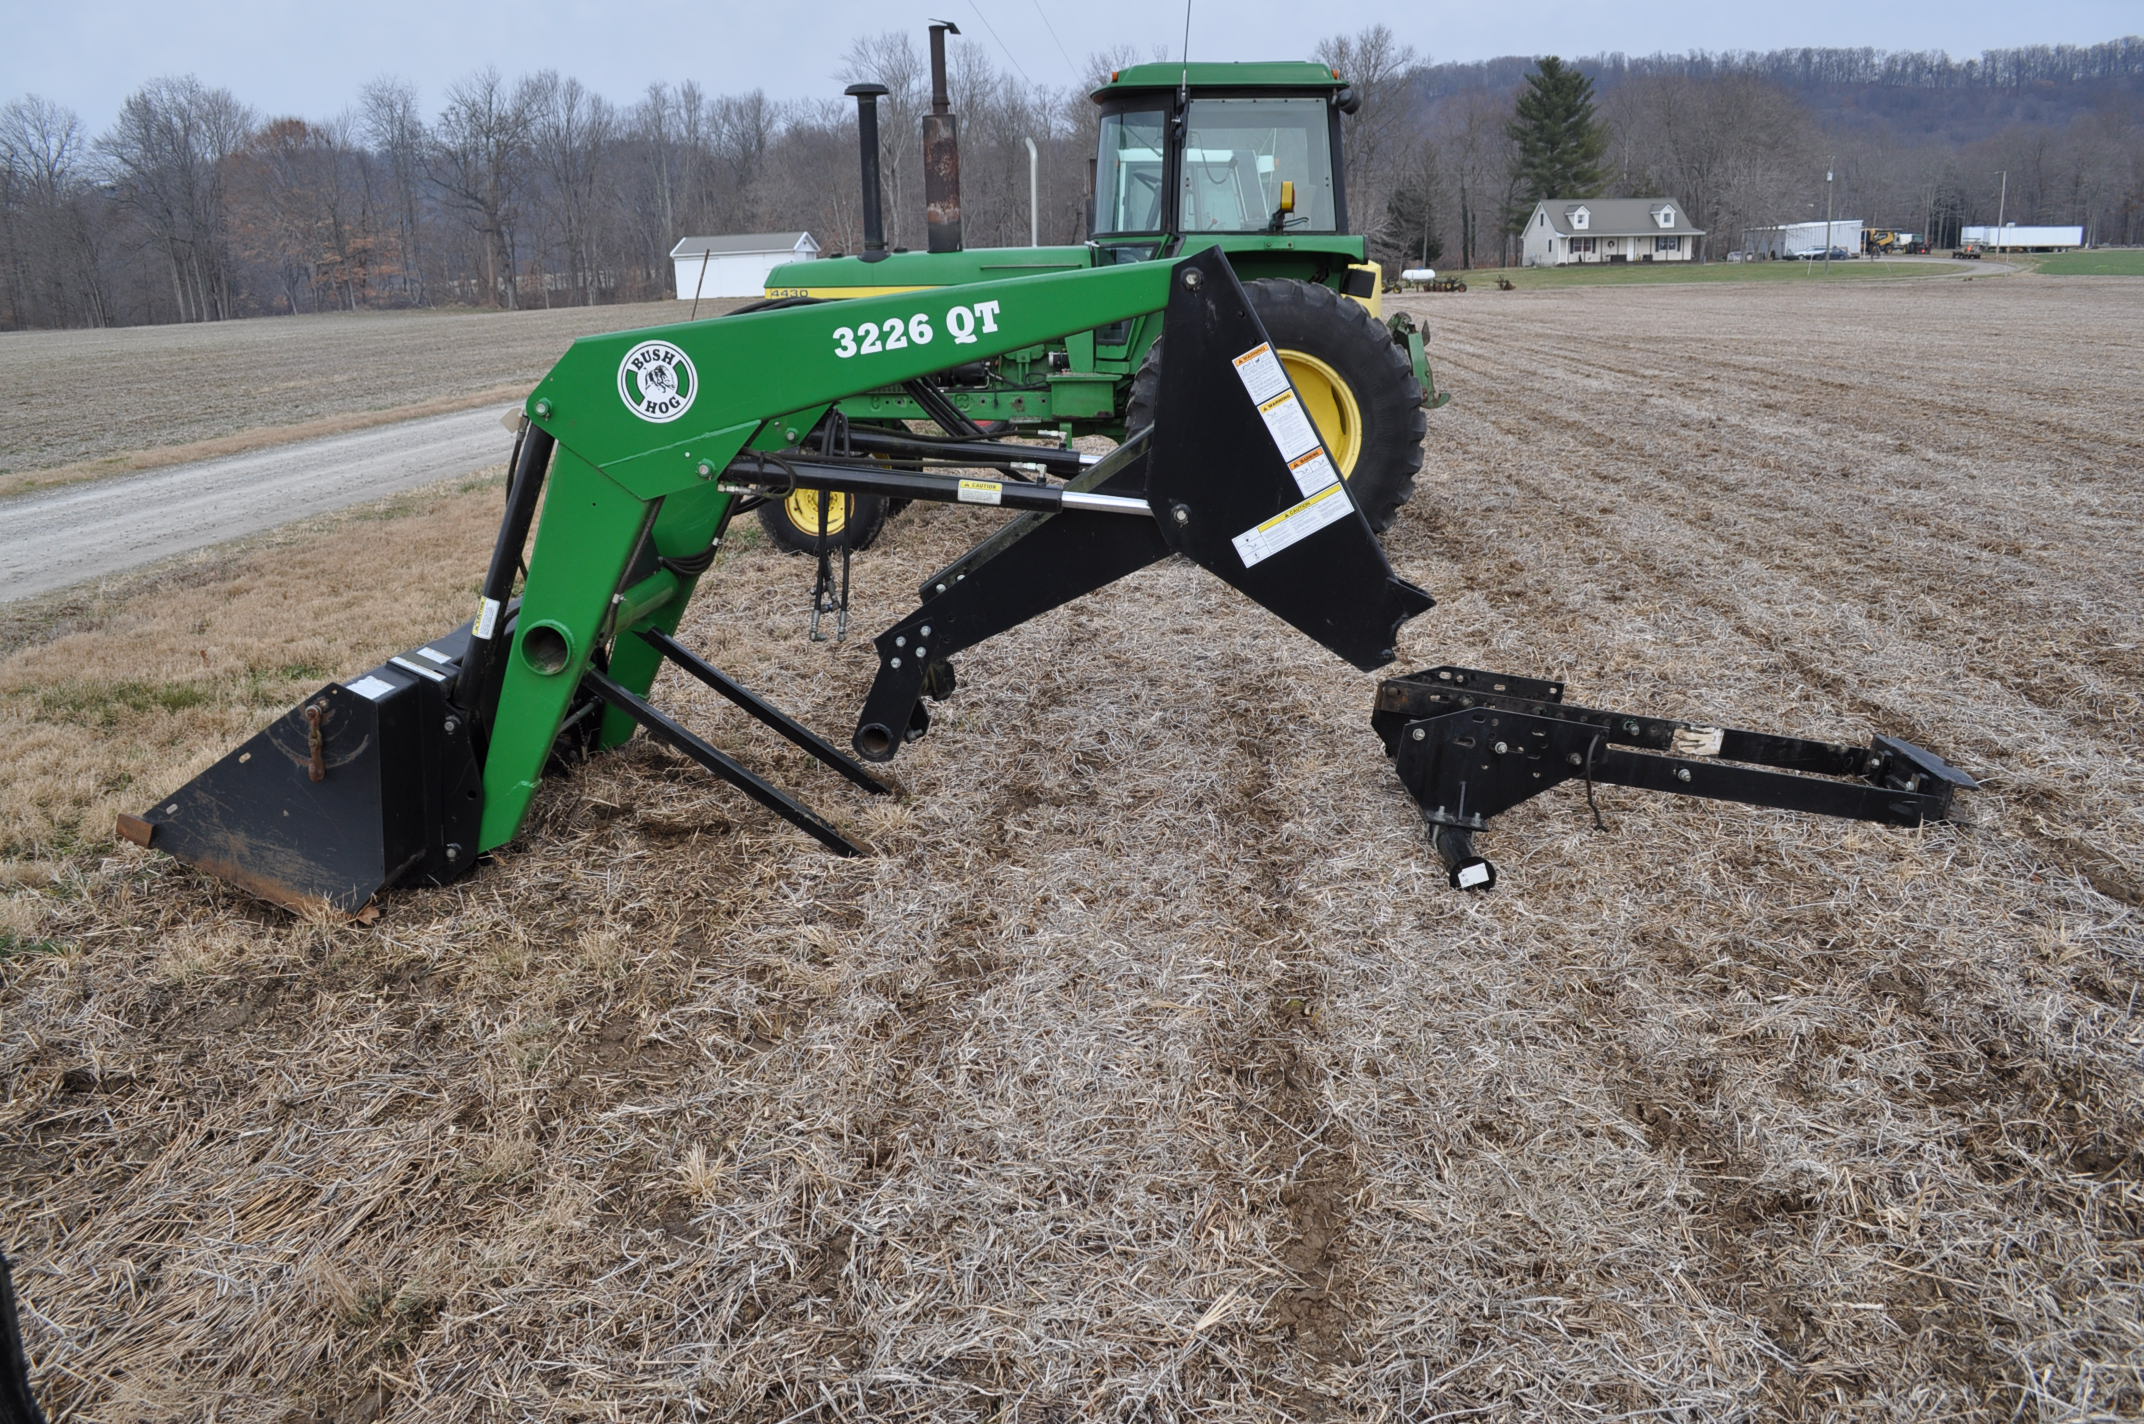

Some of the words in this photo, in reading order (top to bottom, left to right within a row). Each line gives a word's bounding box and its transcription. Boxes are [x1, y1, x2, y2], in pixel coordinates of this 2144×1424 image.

[771, 289, 808, 297] 4430
[832, 313, 933, 358] 3226
[946, 300, 1000, 344] QT
[631, 349, 676, 370] BUSH
[645, 397, 681, 414] HOG
[1289, 502, 1311, 515] CAUTION
